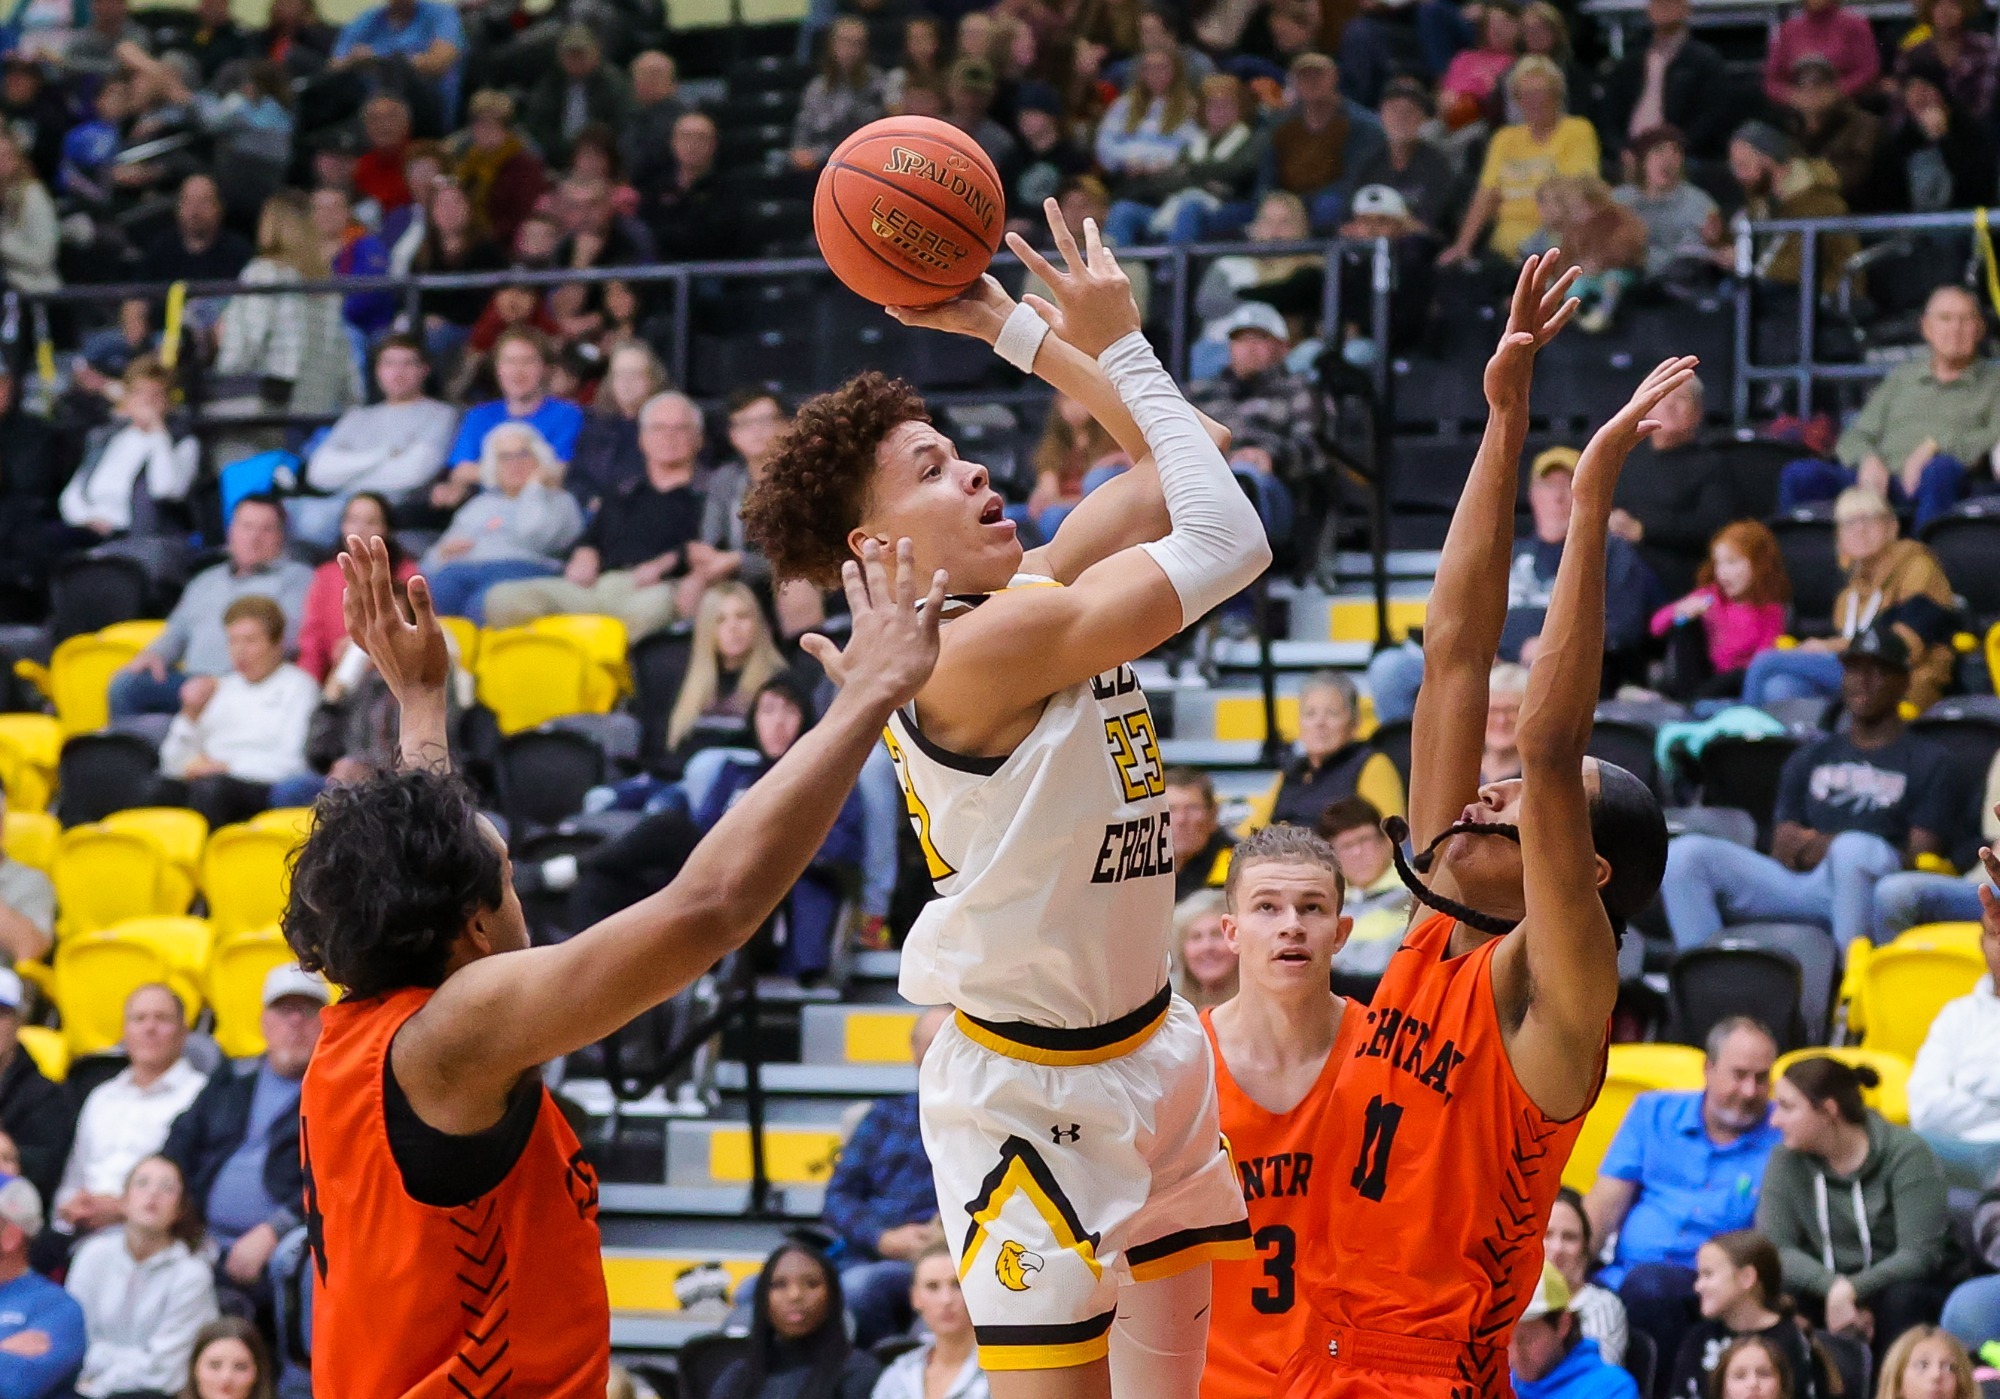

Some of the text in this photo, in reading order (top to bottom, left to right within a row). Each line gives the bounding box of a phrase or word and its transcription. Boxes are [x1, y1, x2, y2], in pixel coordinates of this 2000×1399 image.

[870, 195, 969, 262] LEGACY
[883, 146, 996, 230] SPALDING
[1104, 708, 1166, 804] 23
[1238, 1152, 1314, 1202] NTR
[1351, 1093, 1404, 1203] 11
[1251, 1224, 1296, 1315] 3
